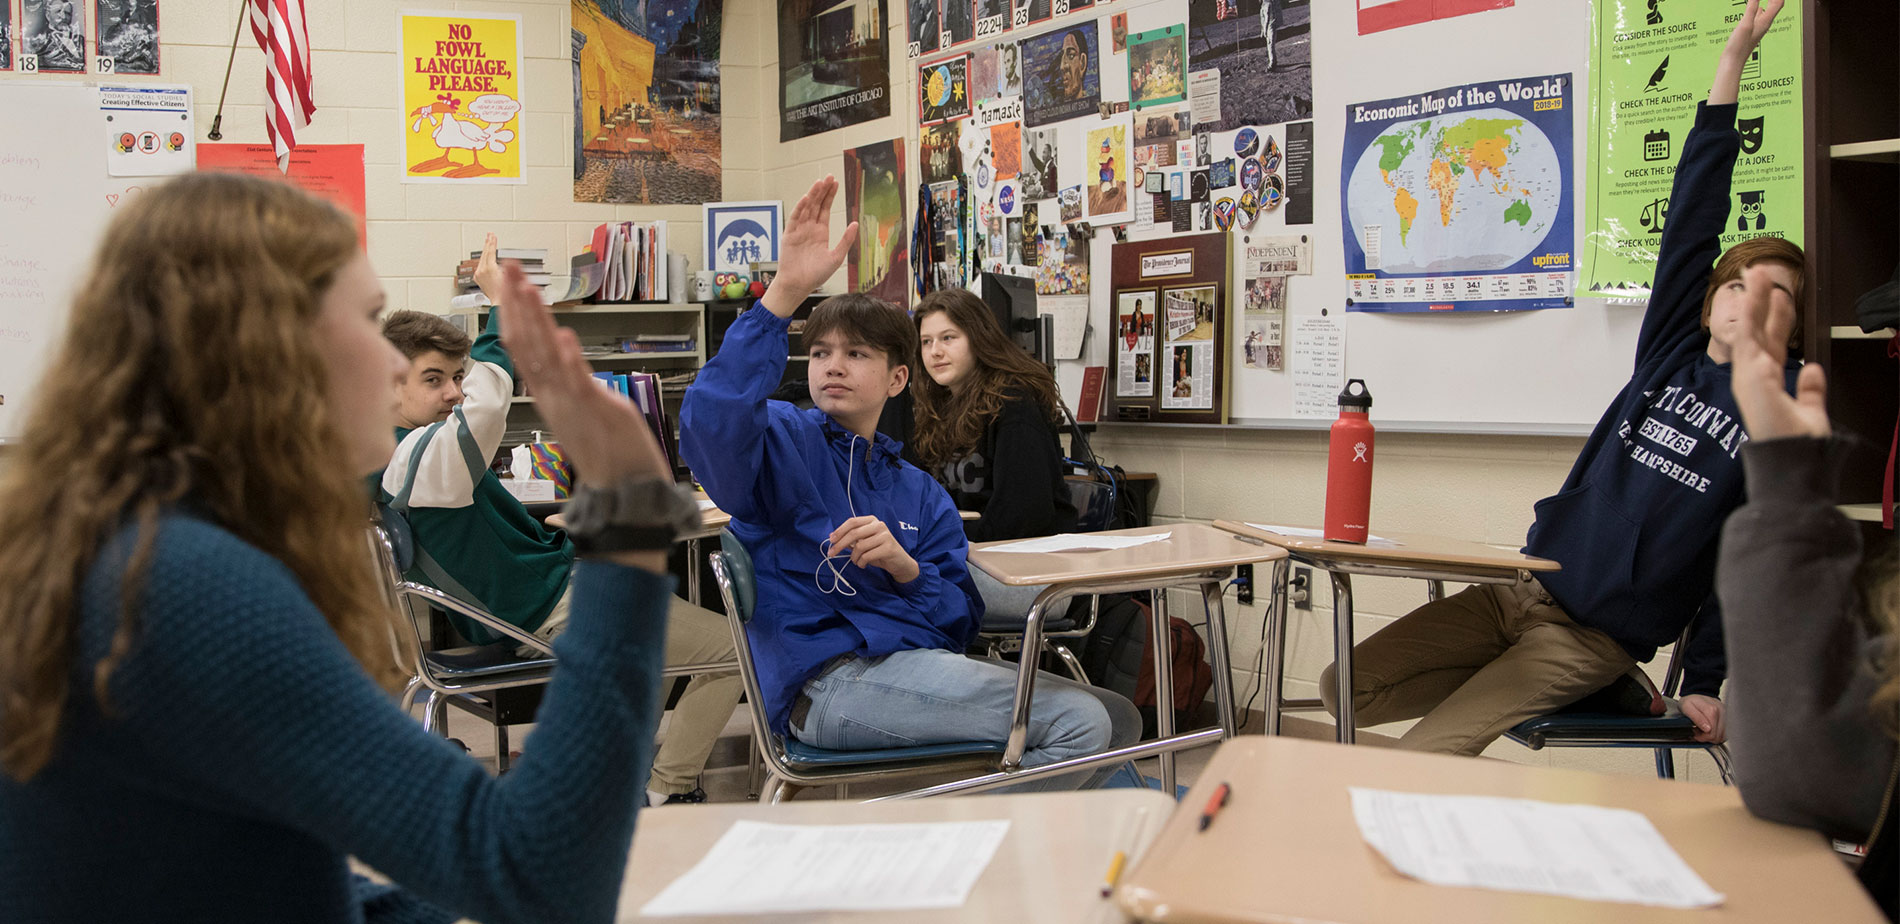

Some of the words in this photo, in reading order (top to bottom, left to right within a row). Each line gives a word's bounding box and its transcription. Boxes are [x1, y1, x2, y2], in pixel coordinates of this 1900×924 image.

[1056, 0, 1069, 13] 25
[978, 21, 988, 35] 22
[989, 15, 1002, 33] 24
[1016, 10, 1027, 25] 23
[448, 24, 472, 40] NO
[943, 32, 951, 47] 21
[1613, 30, 1651, 43] CONSIDER
[1653, 27, 1667, 36] THE
[1668, 21, 1697, 34] SOURCE
[435, 40, 486, 58] FOWL
[909, 44, 920, 57] 20
[19, 56, 35, 71] 18
[97, 58, 112, 72] 19
[415, 57, 512, 80] LANGUAGE,
[429, 75, 498, 92] PLEASE.
[1756, 76, 1795, 90] SOURCES?
[102, 98, 130, 106] Creating
[818, 97, 847, 113] INSTITUTE
[855, 87, 883, 104] CHICAGO
[1355, 99, 1419, 123] Economic
[1421, 94, 1446, 116] Map
[1448, 89, 1464, 109] of
[1467, 86, 1497, 106] the
[1499, 78, 1563, 102] World
[1535, 99, 1561, 109] 2018-19
[1620, 100, 1643, 110] CHECK
[1646, 97, 1659, 106] THE
[1661, 92, 1693, 105] AUTHOR
[982, 101, 1021, 124] namaste
[1752, 154, 1775, 166] JOKE?
[1624, 168, 1649, 178] CHECK
[1650, 166, 1665, 176] THE
[1617, 238, 1643, 248] CHECK
[1644, 237, 1661, 247] YOU
[1721, 234, 1736, 243] ASK
[1737, 233, 1751, 242] THE
[1533, 252, 1570, 268] upfront
[1466, 281, 1481, 289] 34.1
[1674, 392, 1749, 459] CONWAY
[1630, 445, 1711, 493] HAMPSHIRE
